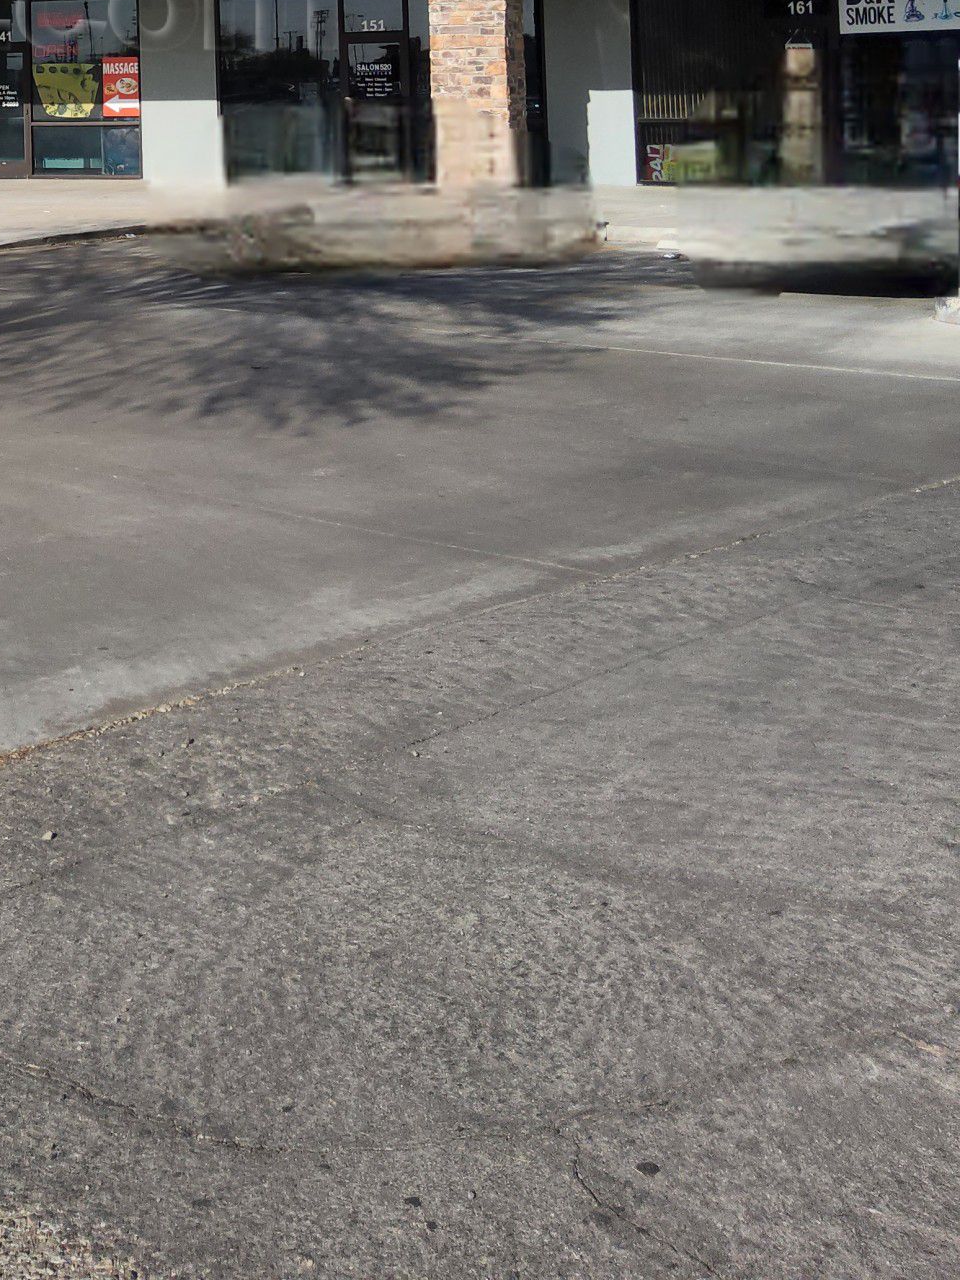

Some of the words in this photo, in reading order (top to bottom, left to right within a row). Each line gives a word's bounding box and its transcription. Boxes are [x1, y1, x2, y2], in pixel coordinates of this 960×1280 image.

[787, 1, 814, 14] 161
[846, 6, 895, 26] SMOKE
[361, 20, 385, 31] 151
[102, 62, 139, 74] MASSAGE
[356, 63, 380, 71] SALON
[380, 63, 392, 71] 520
